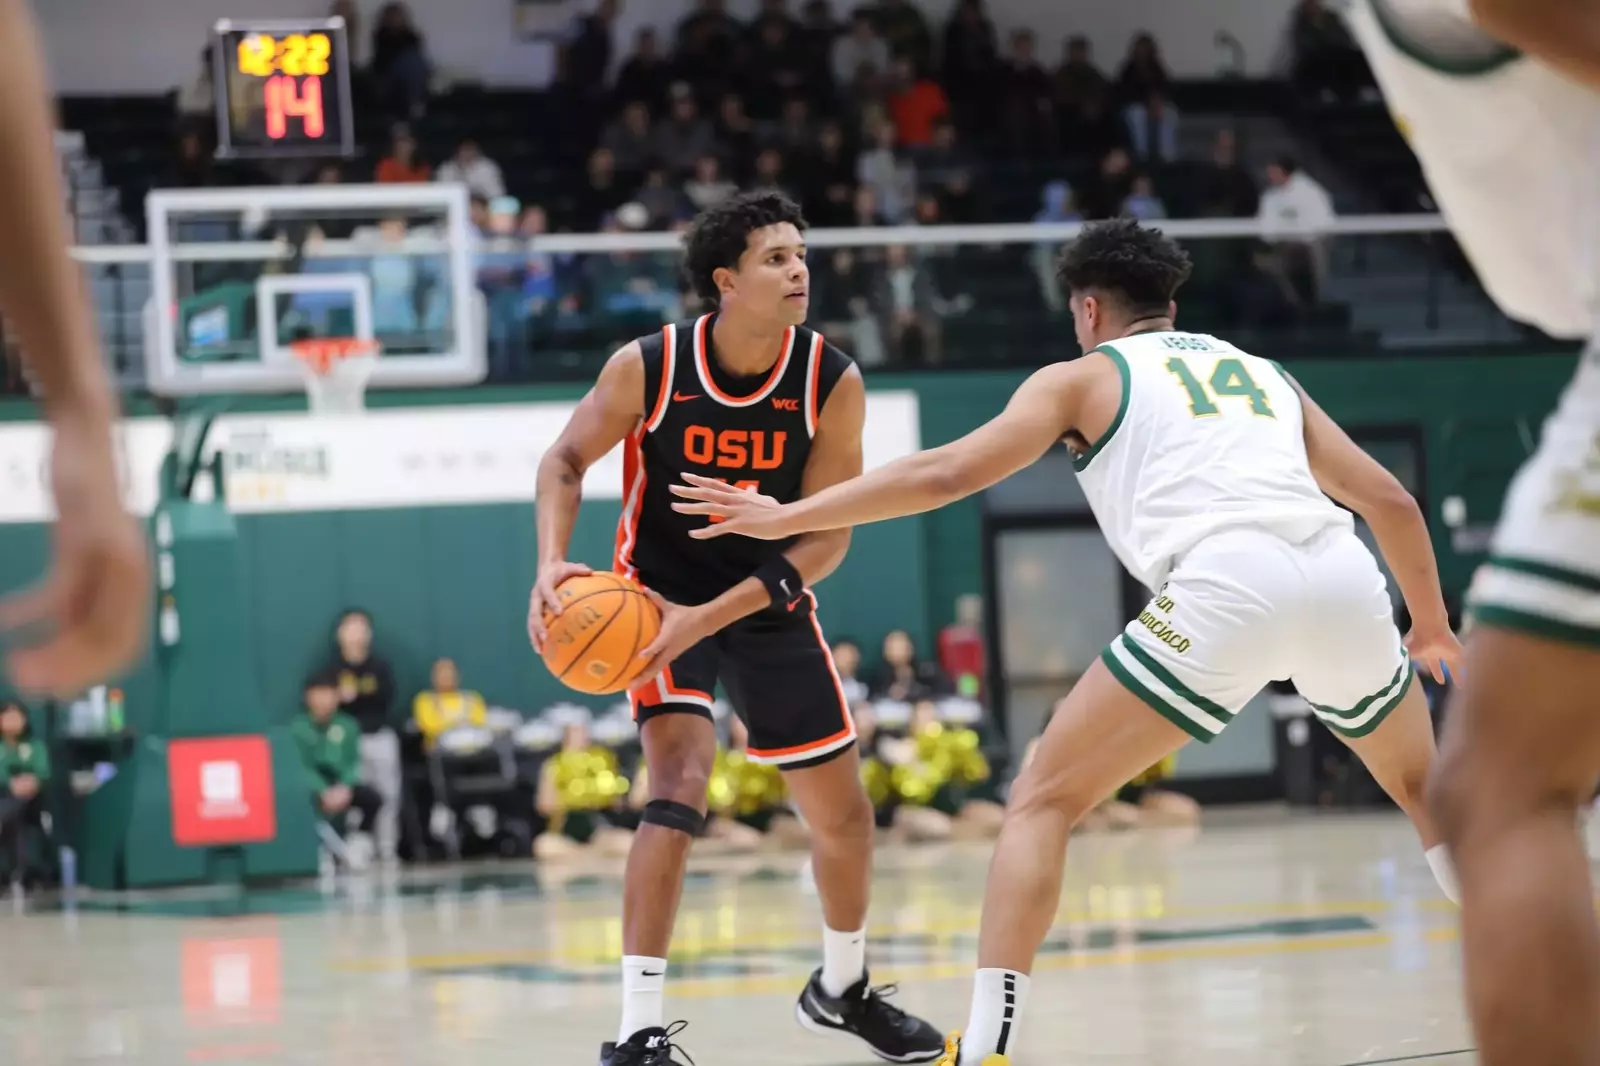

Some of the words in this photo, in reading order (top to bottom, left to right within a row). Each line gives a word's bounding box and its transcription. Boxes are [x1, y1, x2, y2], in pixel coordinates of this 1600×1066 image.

[264, 75, 325, 139] 14
[771, 397, 799, 411] WCC
[1165, 357, 1277, 420] 14
[683, 425, 787, 470] OSU
[1138, 610, 1192, 653] ancisco
